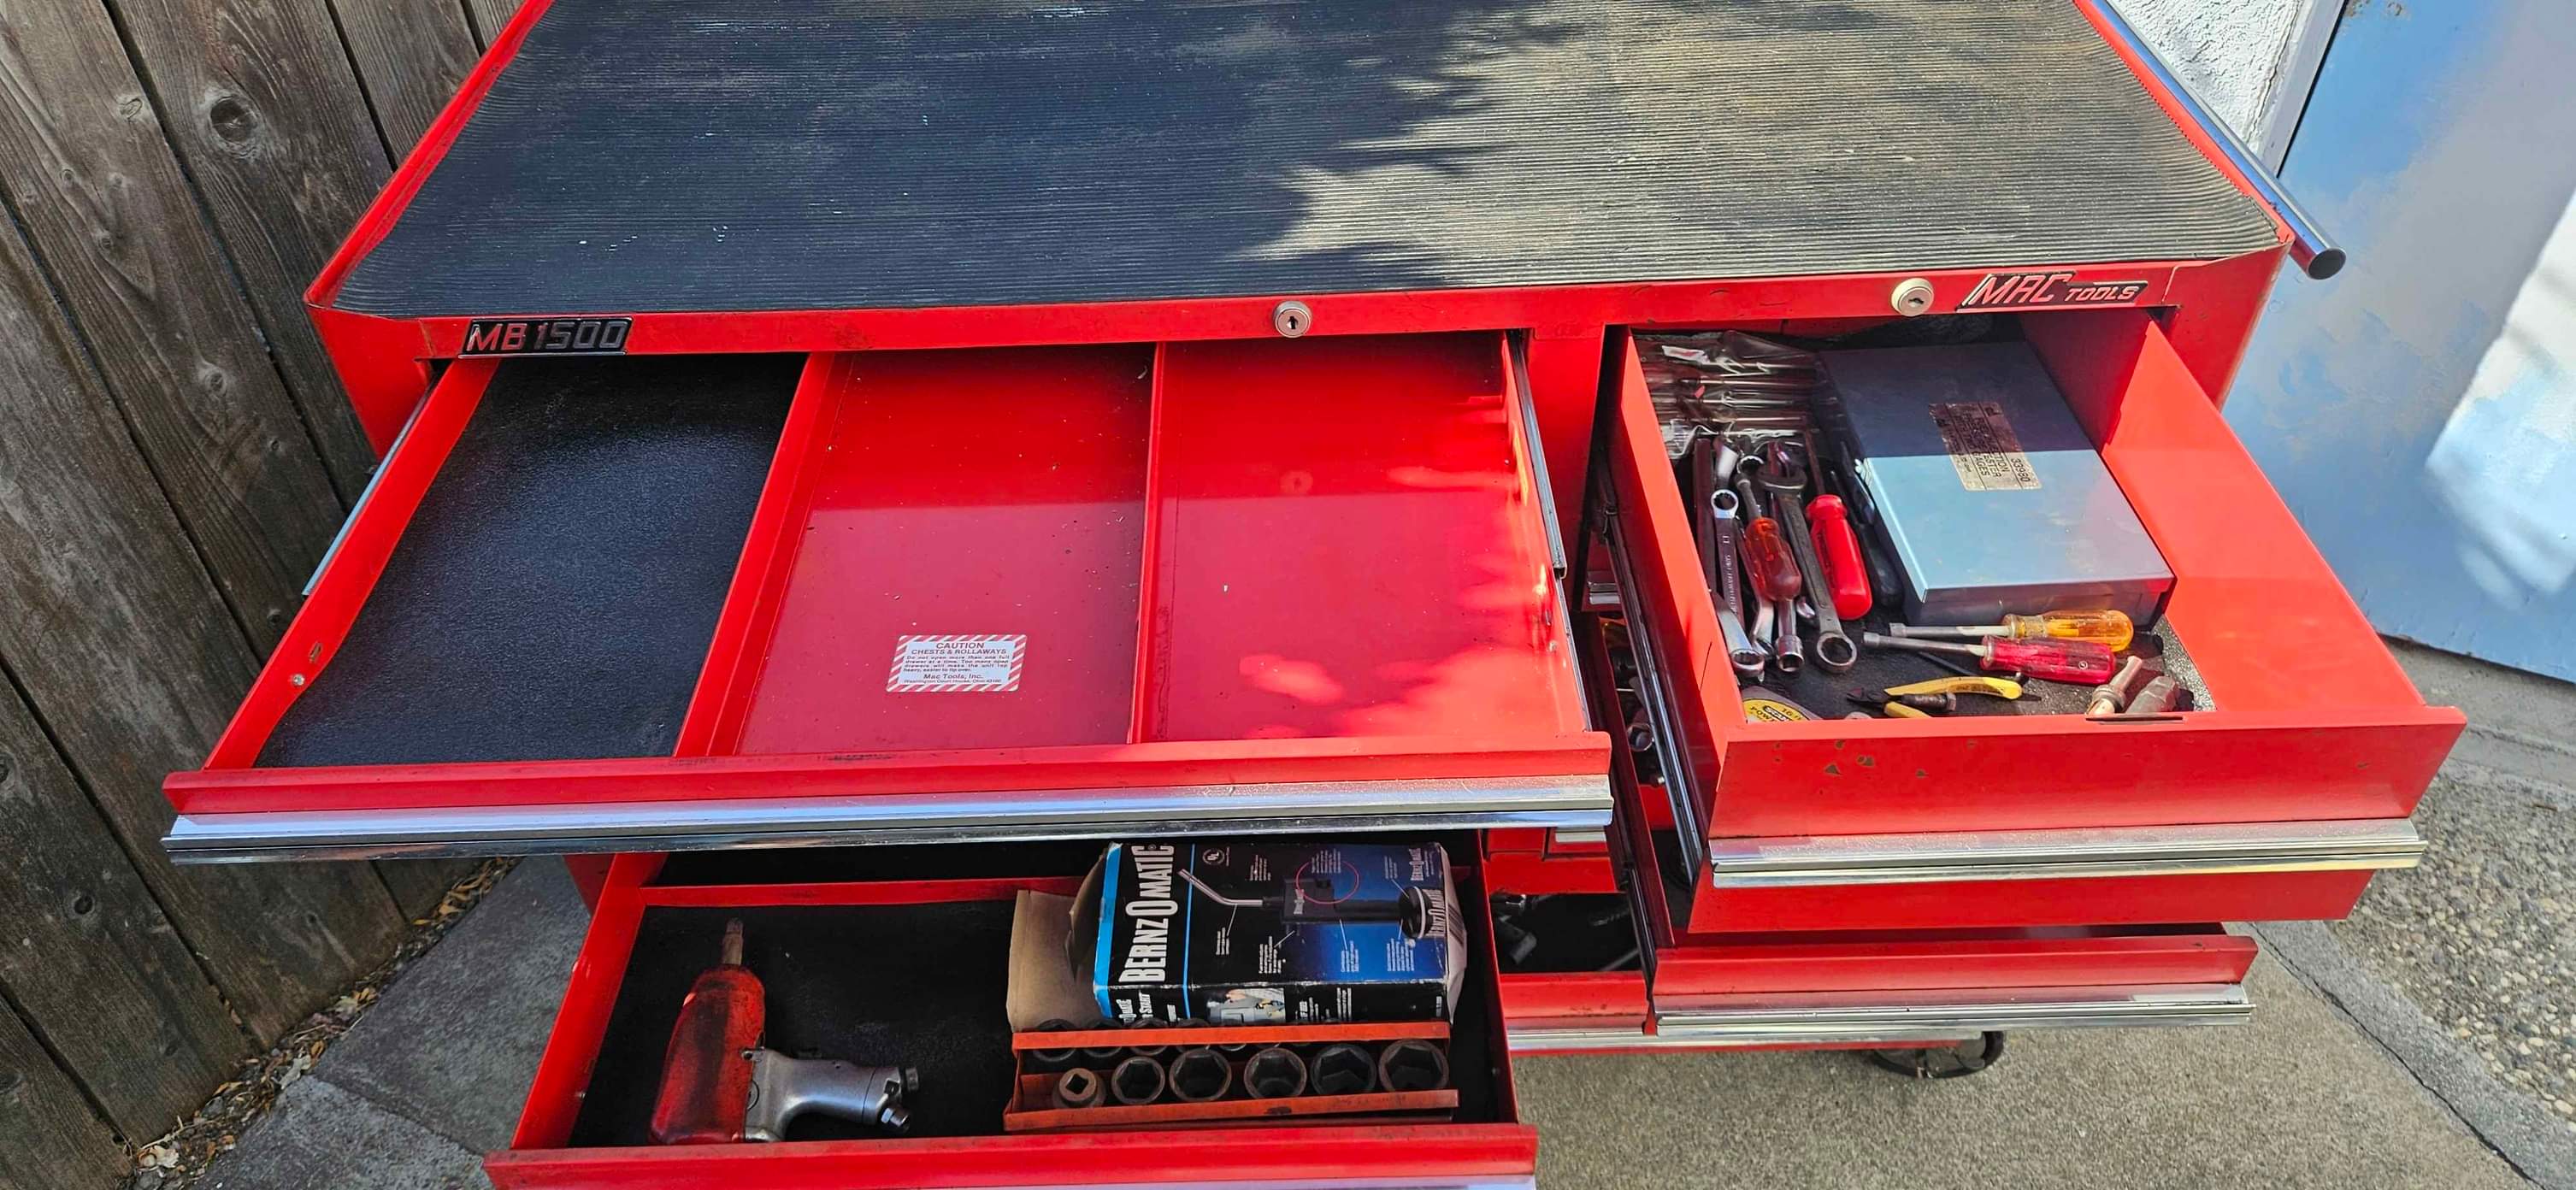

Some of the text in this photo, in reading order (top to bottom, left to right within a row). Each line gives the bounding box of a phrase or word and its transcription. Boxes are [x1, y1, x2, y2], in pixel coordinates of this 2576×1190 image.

[1968, 274, 2139, 305] MAC TOOLS
[467, 321, 628, 351] MB 1500
